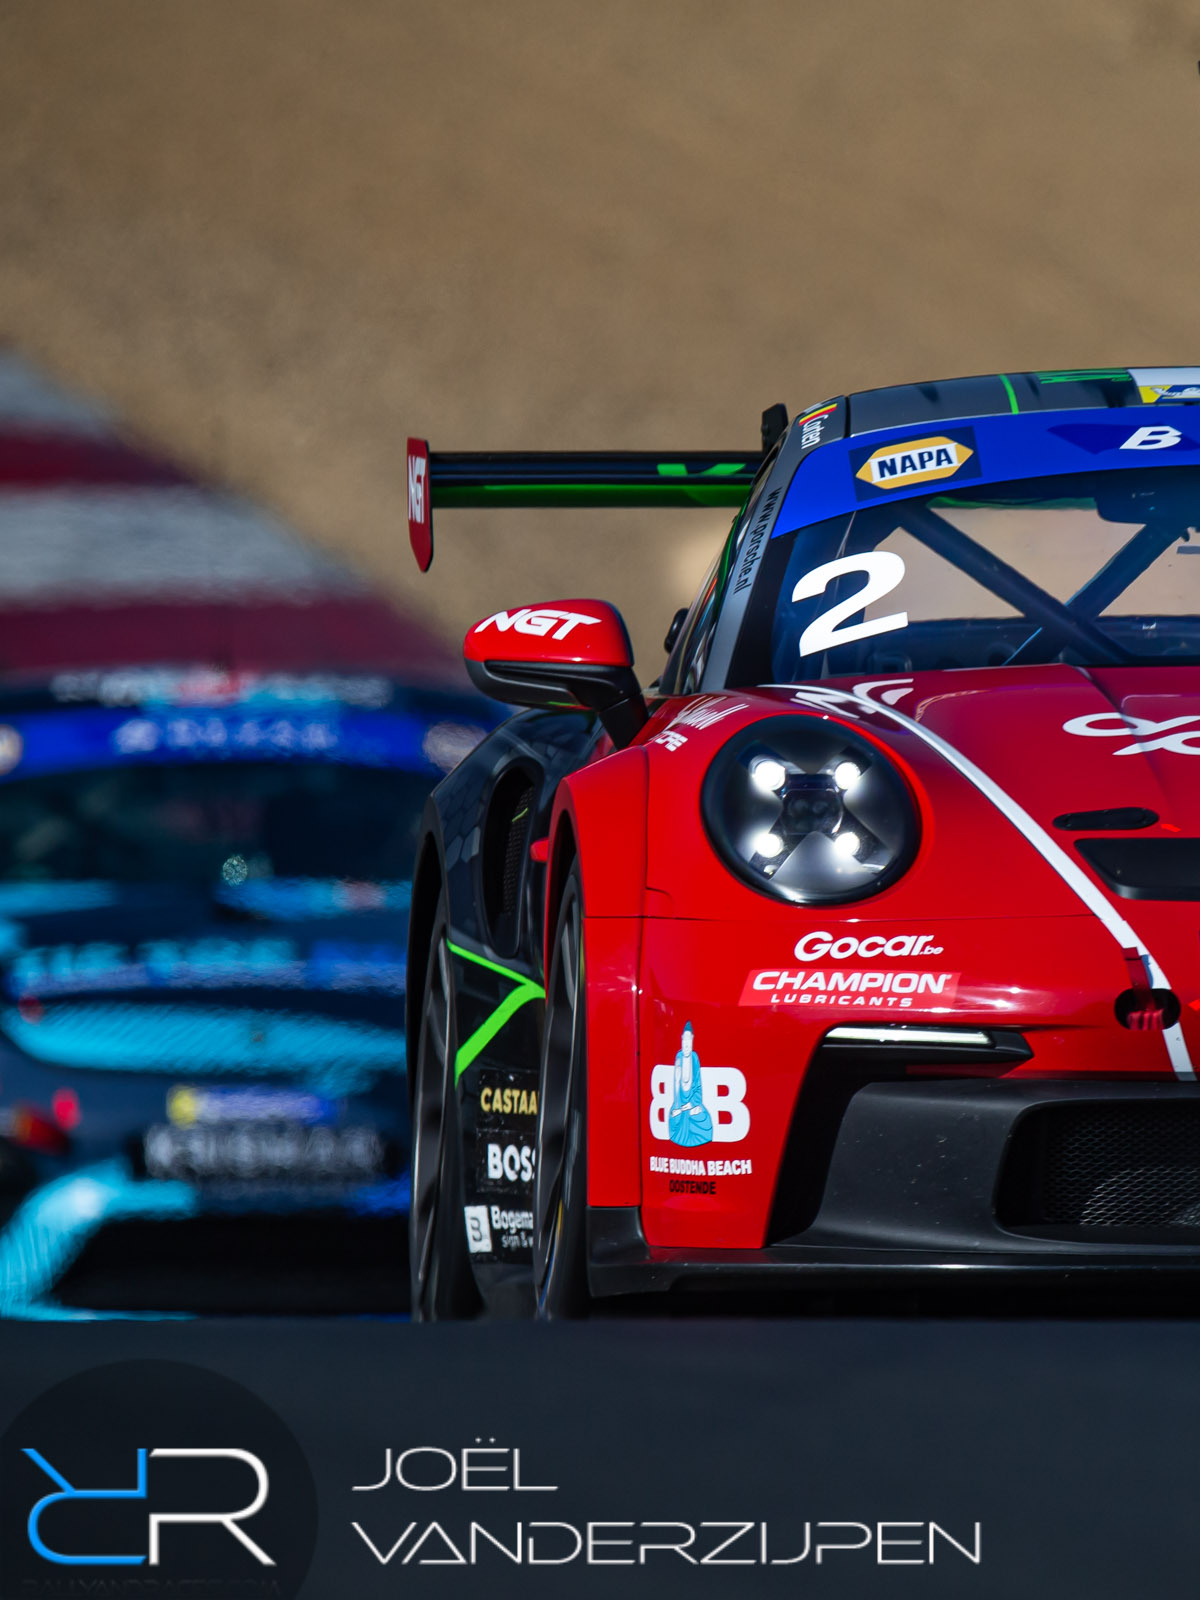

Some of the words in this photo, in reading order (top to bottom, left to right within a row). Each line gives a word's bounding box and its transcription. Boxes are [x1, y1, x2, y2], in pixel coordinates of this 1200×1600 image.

[876, 447, 954, 480] NAPA
[408, 455, 426, 524] NGT
[733, 486, 783, 595] www.porsche.nl
[791, 551, 908, 657] 2
[474, 608, 602, 641] NGT
[753, 971, 947, 994] CHAMPION
[770, 993, 913, 1008] LUBRICANTS
[480, 1087, 539, 1115] CASTAA
[487, 1143, 536, 1182] BOS
[649, 1156, 669, 1173] BLUE
[669, 1158, 707, 1176] BUDDHA
[706, 1159, 753, 1176] BEACH
[669, 1179, 717, 1194] OOSTENDE
